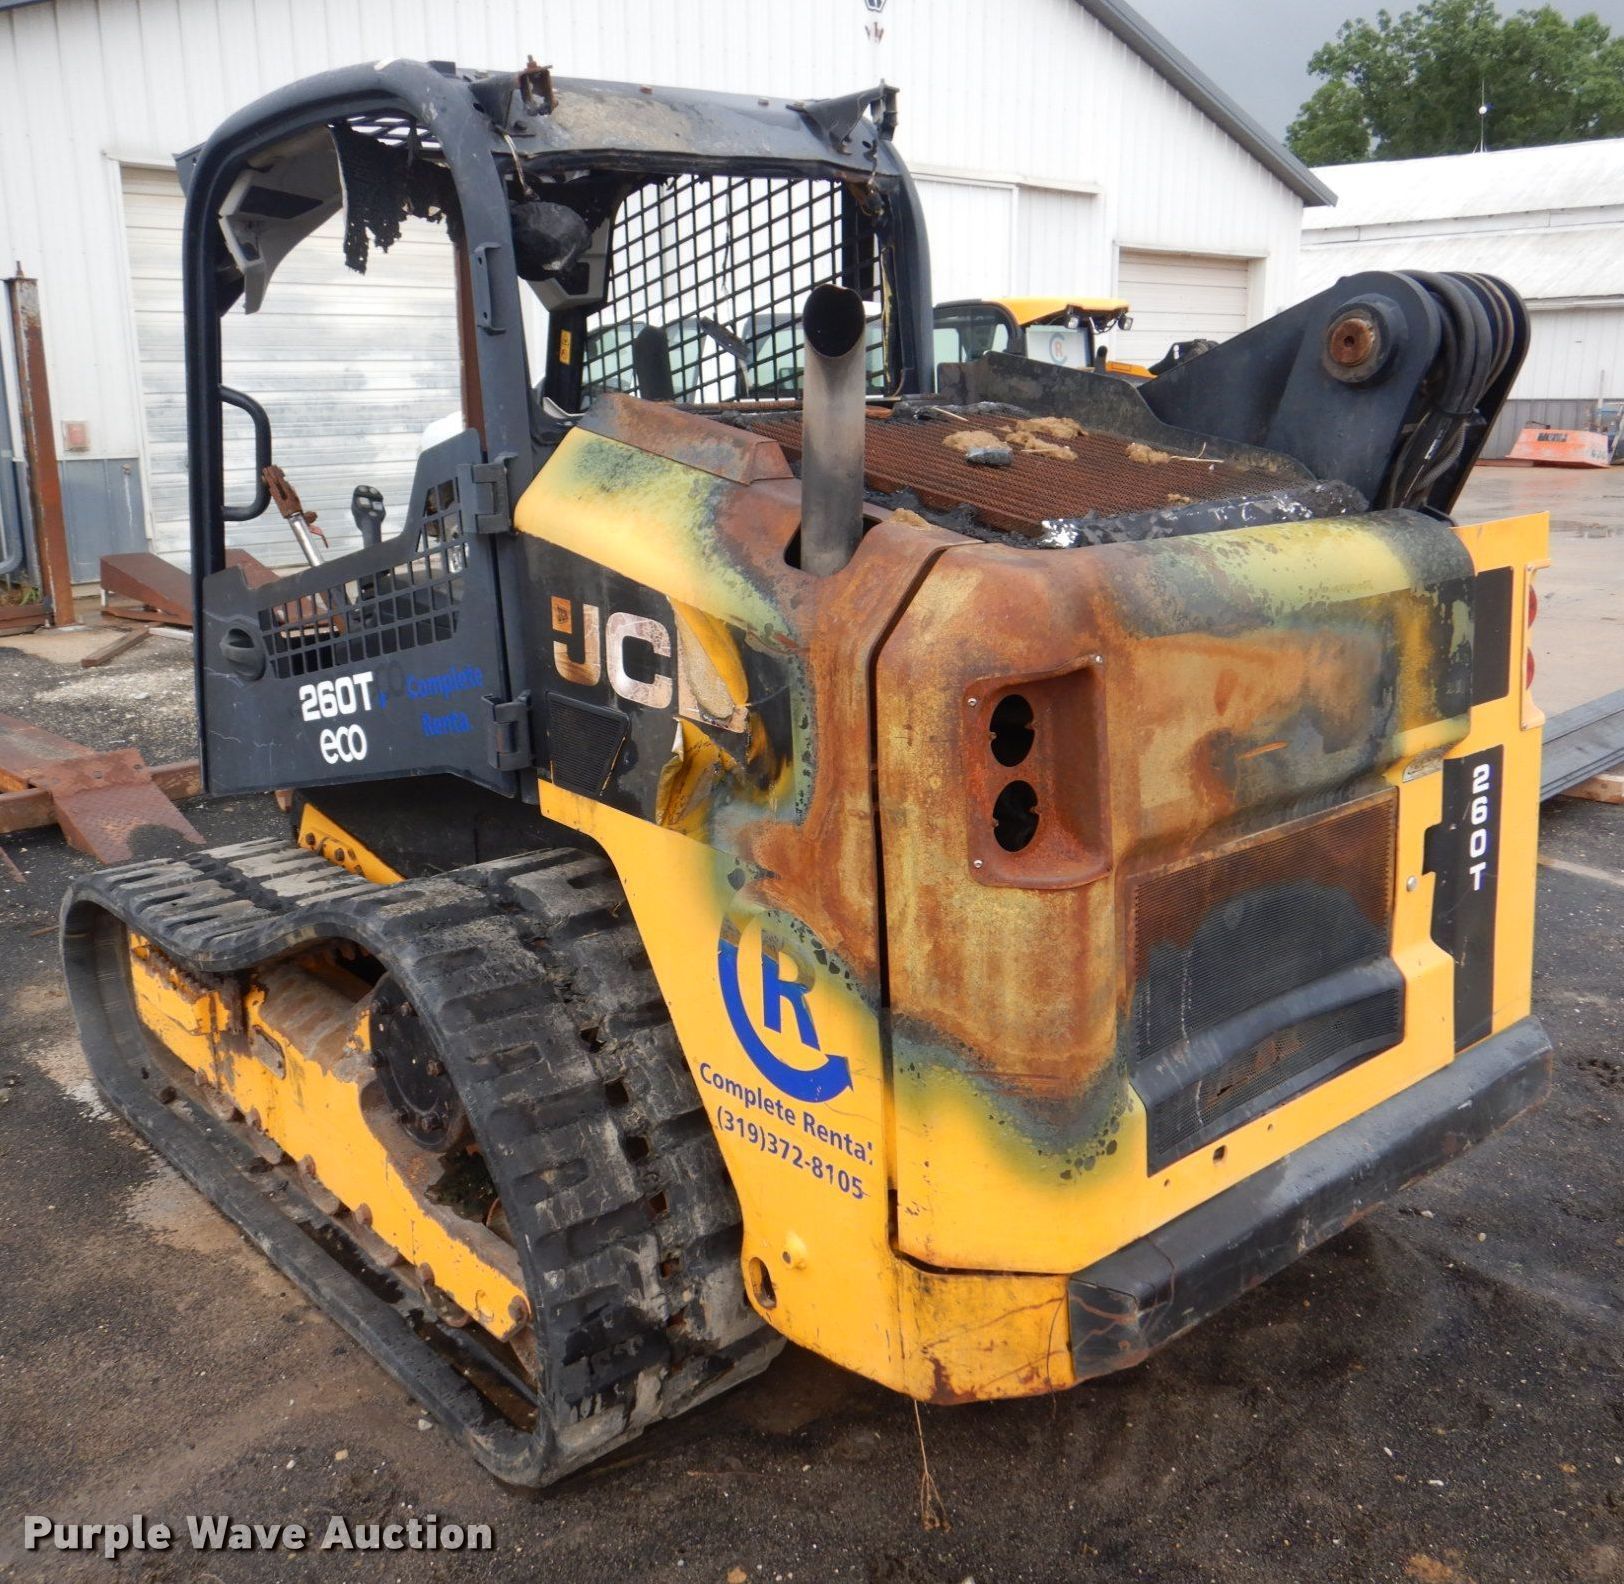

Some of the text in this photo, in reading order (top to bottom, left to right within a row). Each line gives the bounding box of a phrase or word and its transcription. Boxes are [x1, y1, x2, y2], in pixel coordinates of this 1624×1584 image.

[299, 671, 373, 721] 260T
[405, 664, 483, 700] Complete
[320, 724, 368, 764] eco
[421, 711, 473, 736] Renta
[1469, 763, 1490, 891] 260T
[699, 1062, 796, 1126] Complete
[717, 1106, 865, 1200] (319)372-8105
